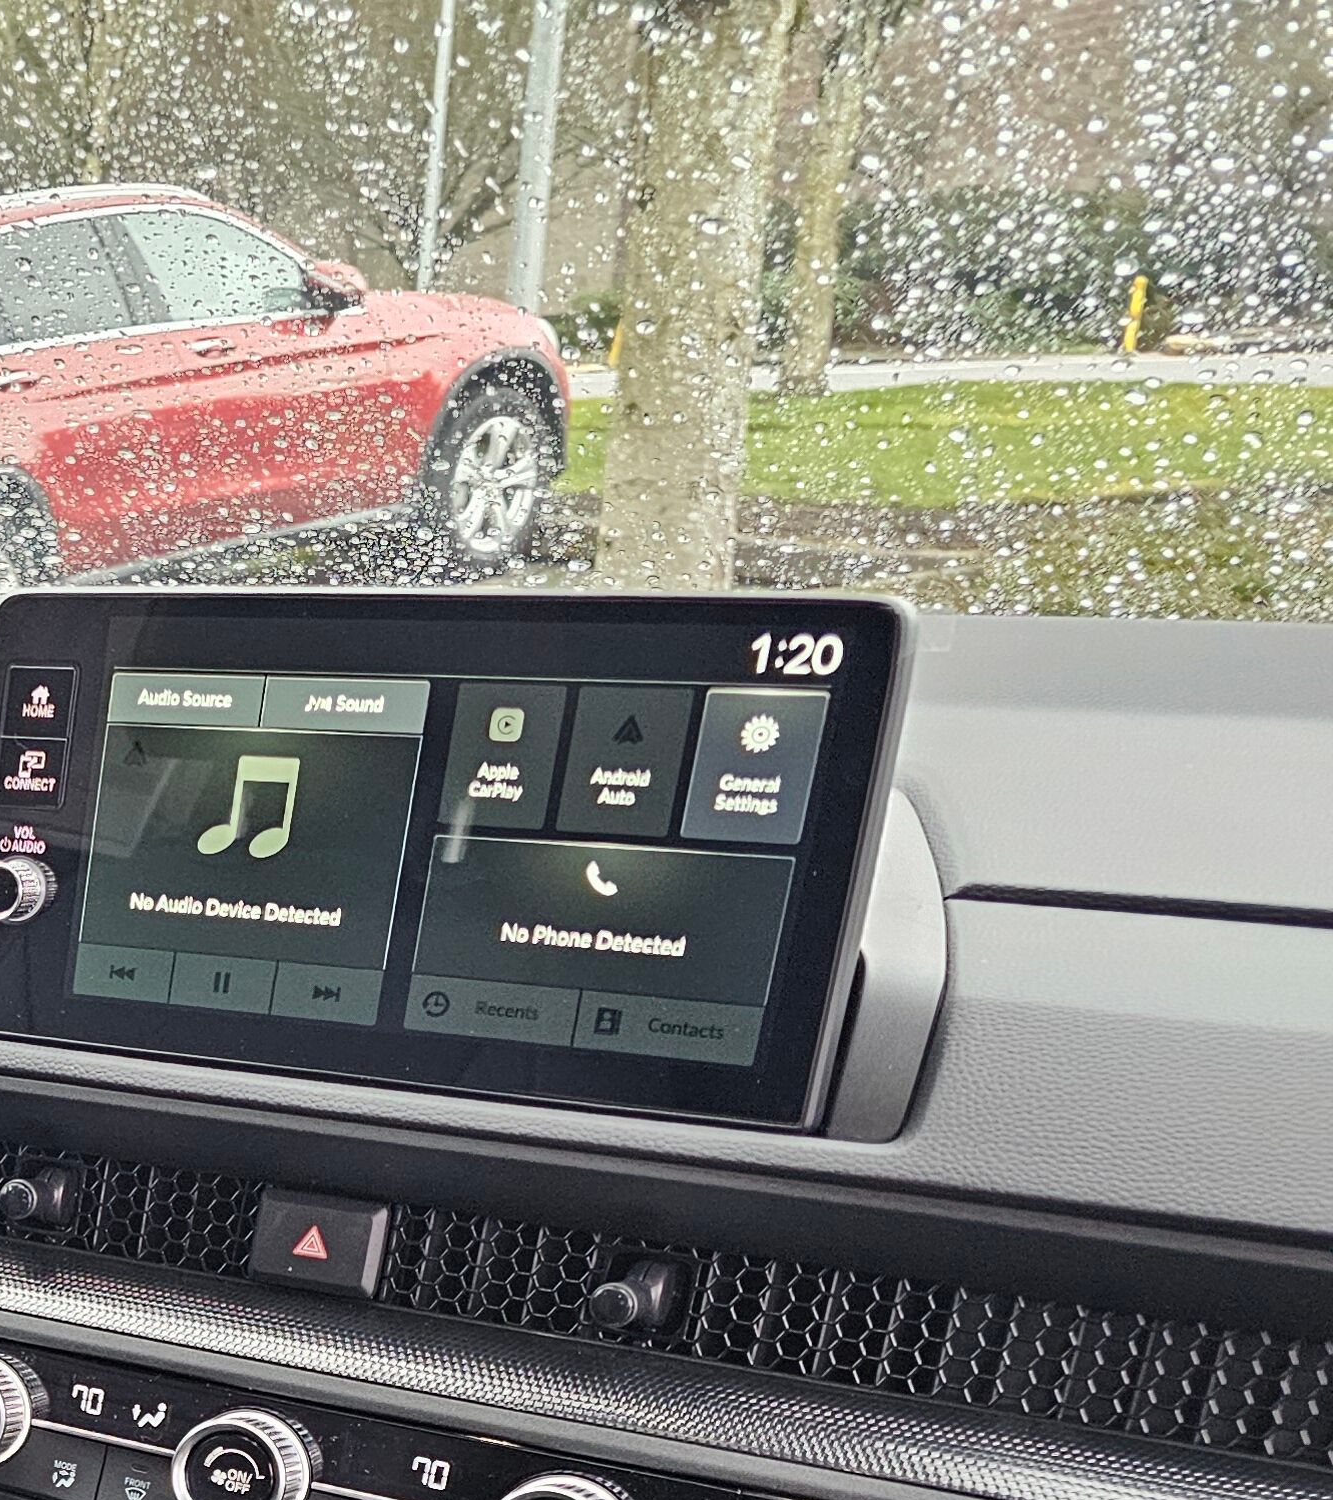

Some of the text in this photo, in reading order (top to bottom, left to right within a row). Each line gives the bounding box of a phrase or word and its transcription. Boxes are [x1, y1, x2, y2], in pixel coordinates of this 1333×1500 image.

[751, 631, 844, 676] 1:20
[137, 688, 233, 708] Audio Source
[335, 694, 385, 713] Sound
[21, 703, 55, 718] HOME
[477, 761, 520, 782] Apple
[589, 767, 651, 789] Android
[3, 775, 56, 792] CONNECT
[468, 780, 523, 802] CarPlay
[719, 773, 781, 794] General
[597, 788, 636, 807] Auto
[714, 794, 778, 816] Settings
[13, 826, 36, 839] VOL
[12, 840, 46, 855] AUDIO
[129, 892, 342, 928] No Audio Device Detected
[500, 921, 687, 957] No Phone Detected
[474, 1000, 539, 1021] Recents
[647, 1017, 724, 1041] Contacts
[71, 1383, 106, 1417] 70
[53, 1459, 77, 1473] MODE
[411, 1455, 451, 1491] 70
[123, 1476, 152, 1491] FRONT
[225, 1480, 251, 1495] OFF
